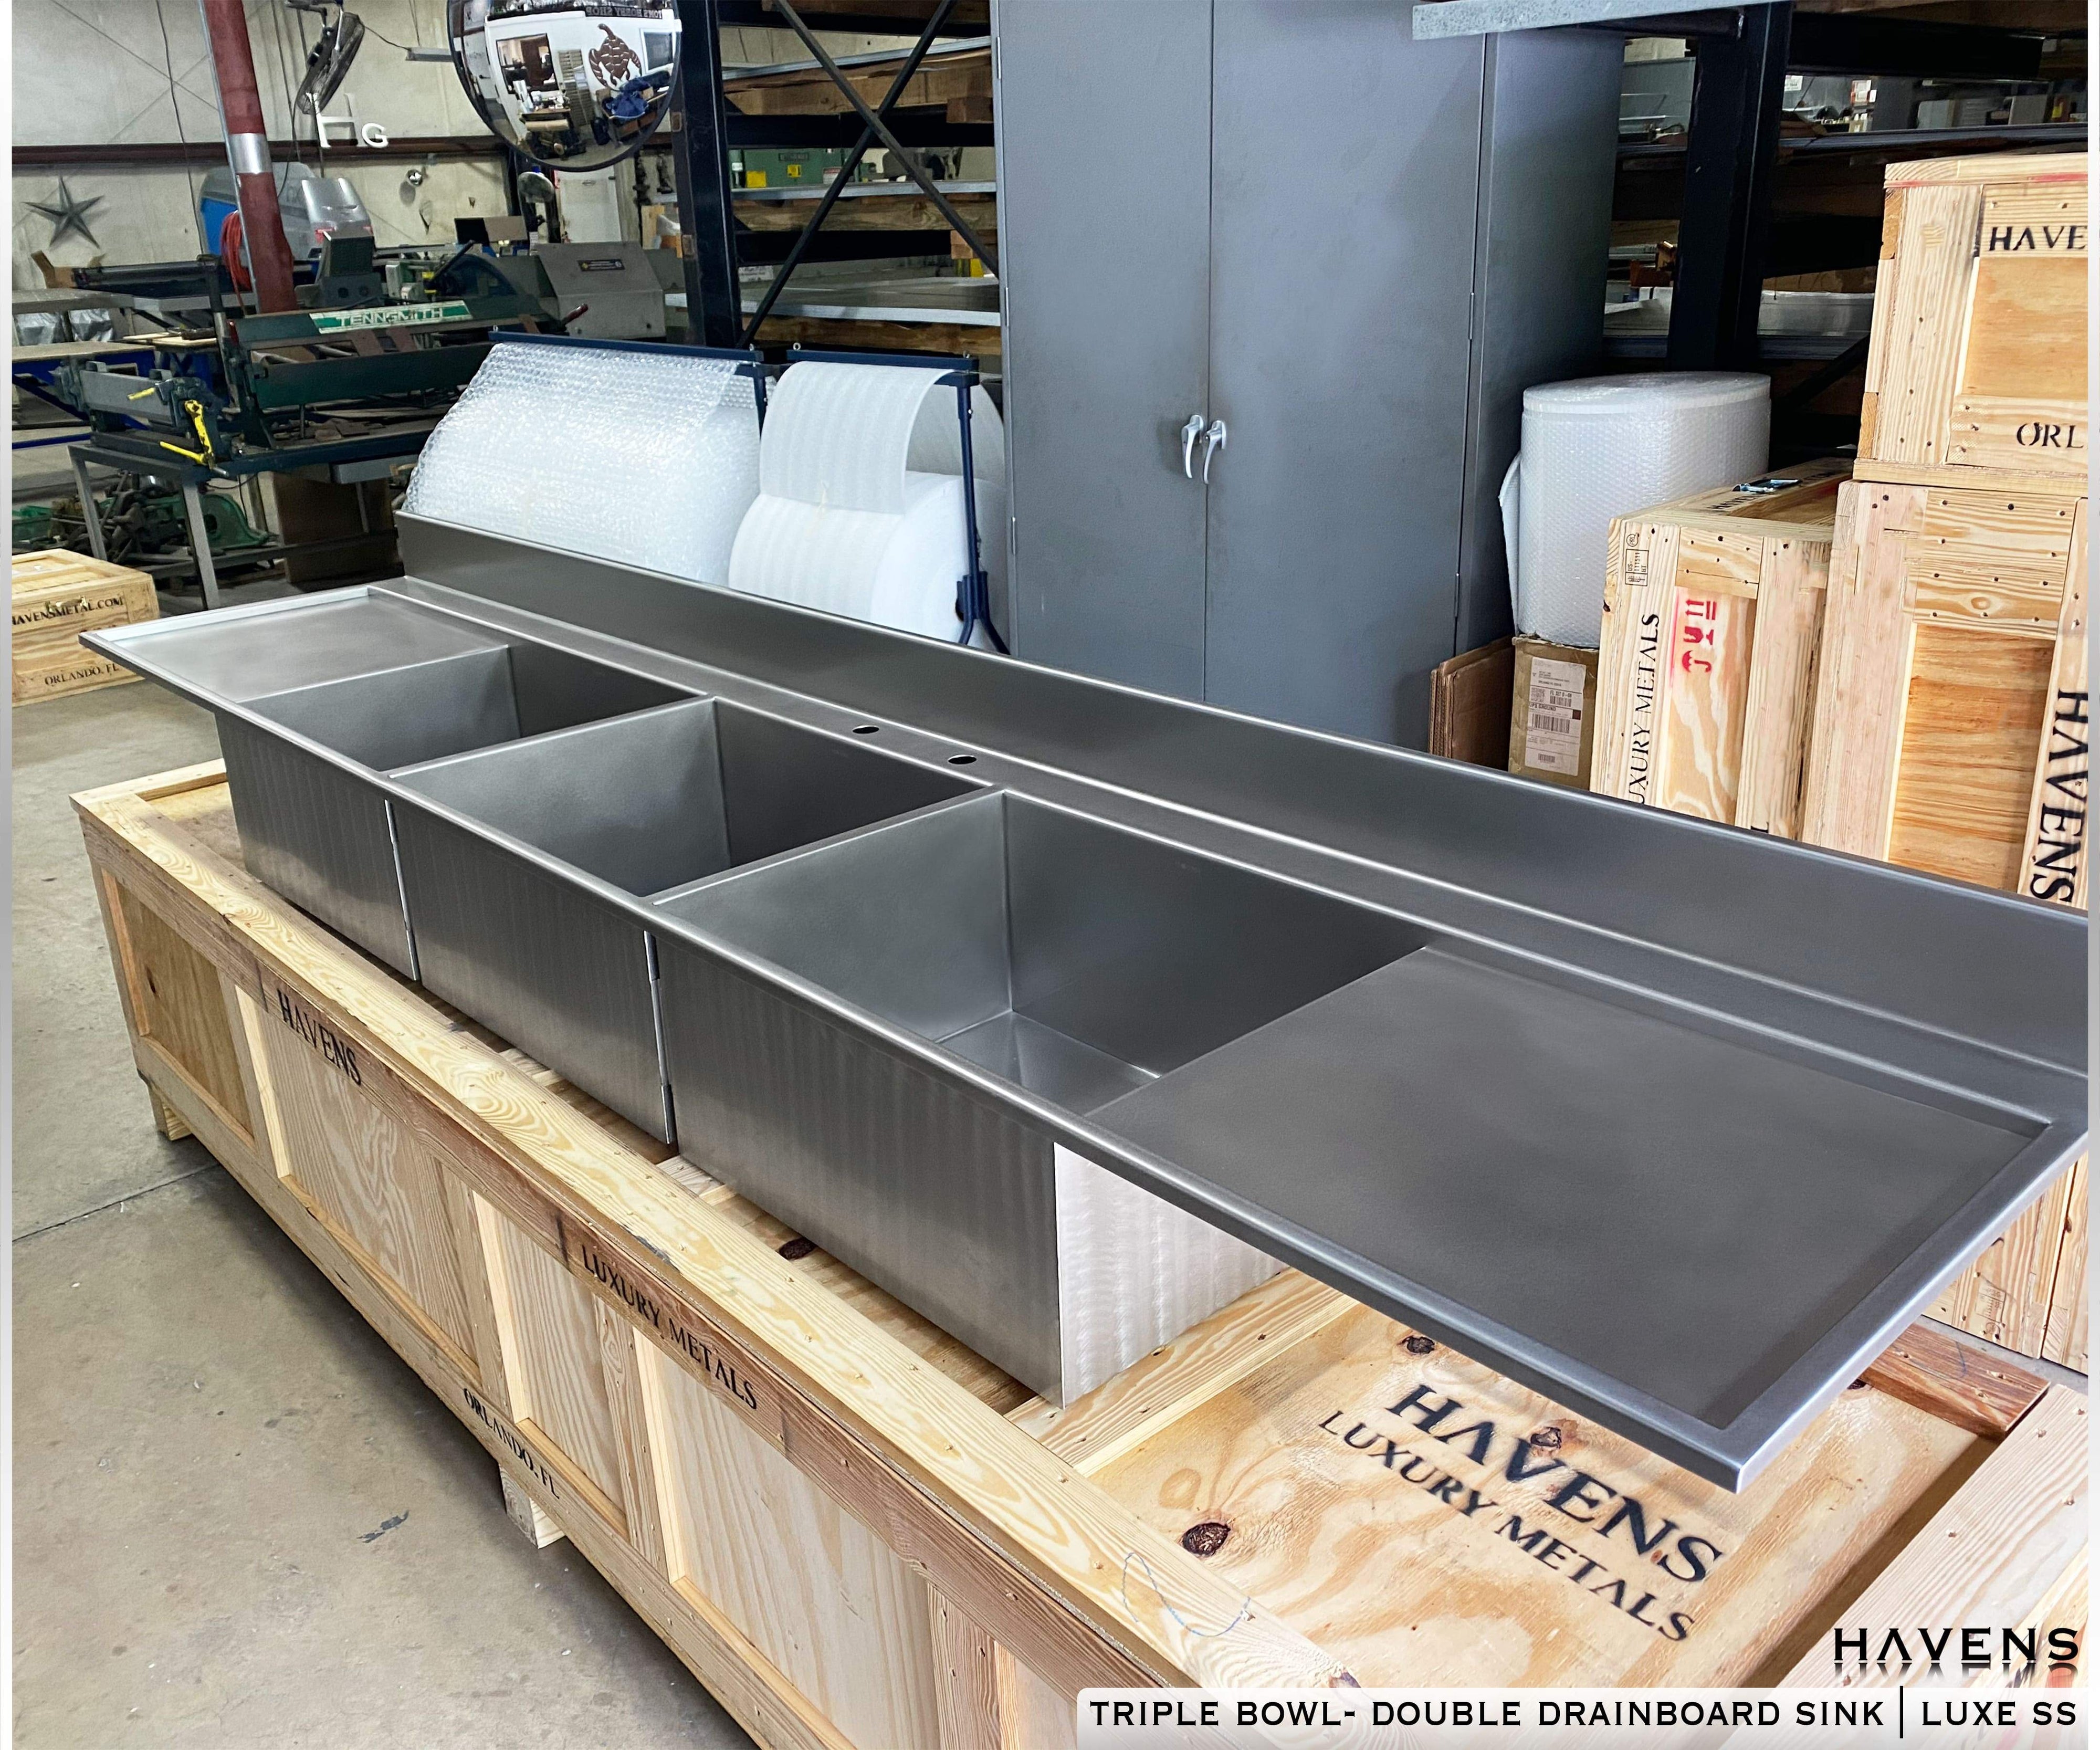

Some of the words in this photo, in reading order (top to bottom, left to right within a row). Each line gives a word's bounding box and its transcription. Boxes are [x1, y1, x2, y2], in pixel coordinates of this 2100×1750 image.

[336, 307, 443, 327] TENNSMITH
[106, 663, 119, 674] FL
[1635, 613, 1660, 714] METALS
[2030, 688, 2088, 903] HAVENS
[277, 988, 362, 1086] HAVENS
[582, 1244, 660, 1329] LUXURY
[669, 1318, 757, 1410] METALS
[540, 1465, 560, 1500] FL
[1319, 1410, 1499, 1517] LUXURY
[1494, 1514, 1696, 1642] METALS
[1385, 1384, 1725, 1582] HAVENS
